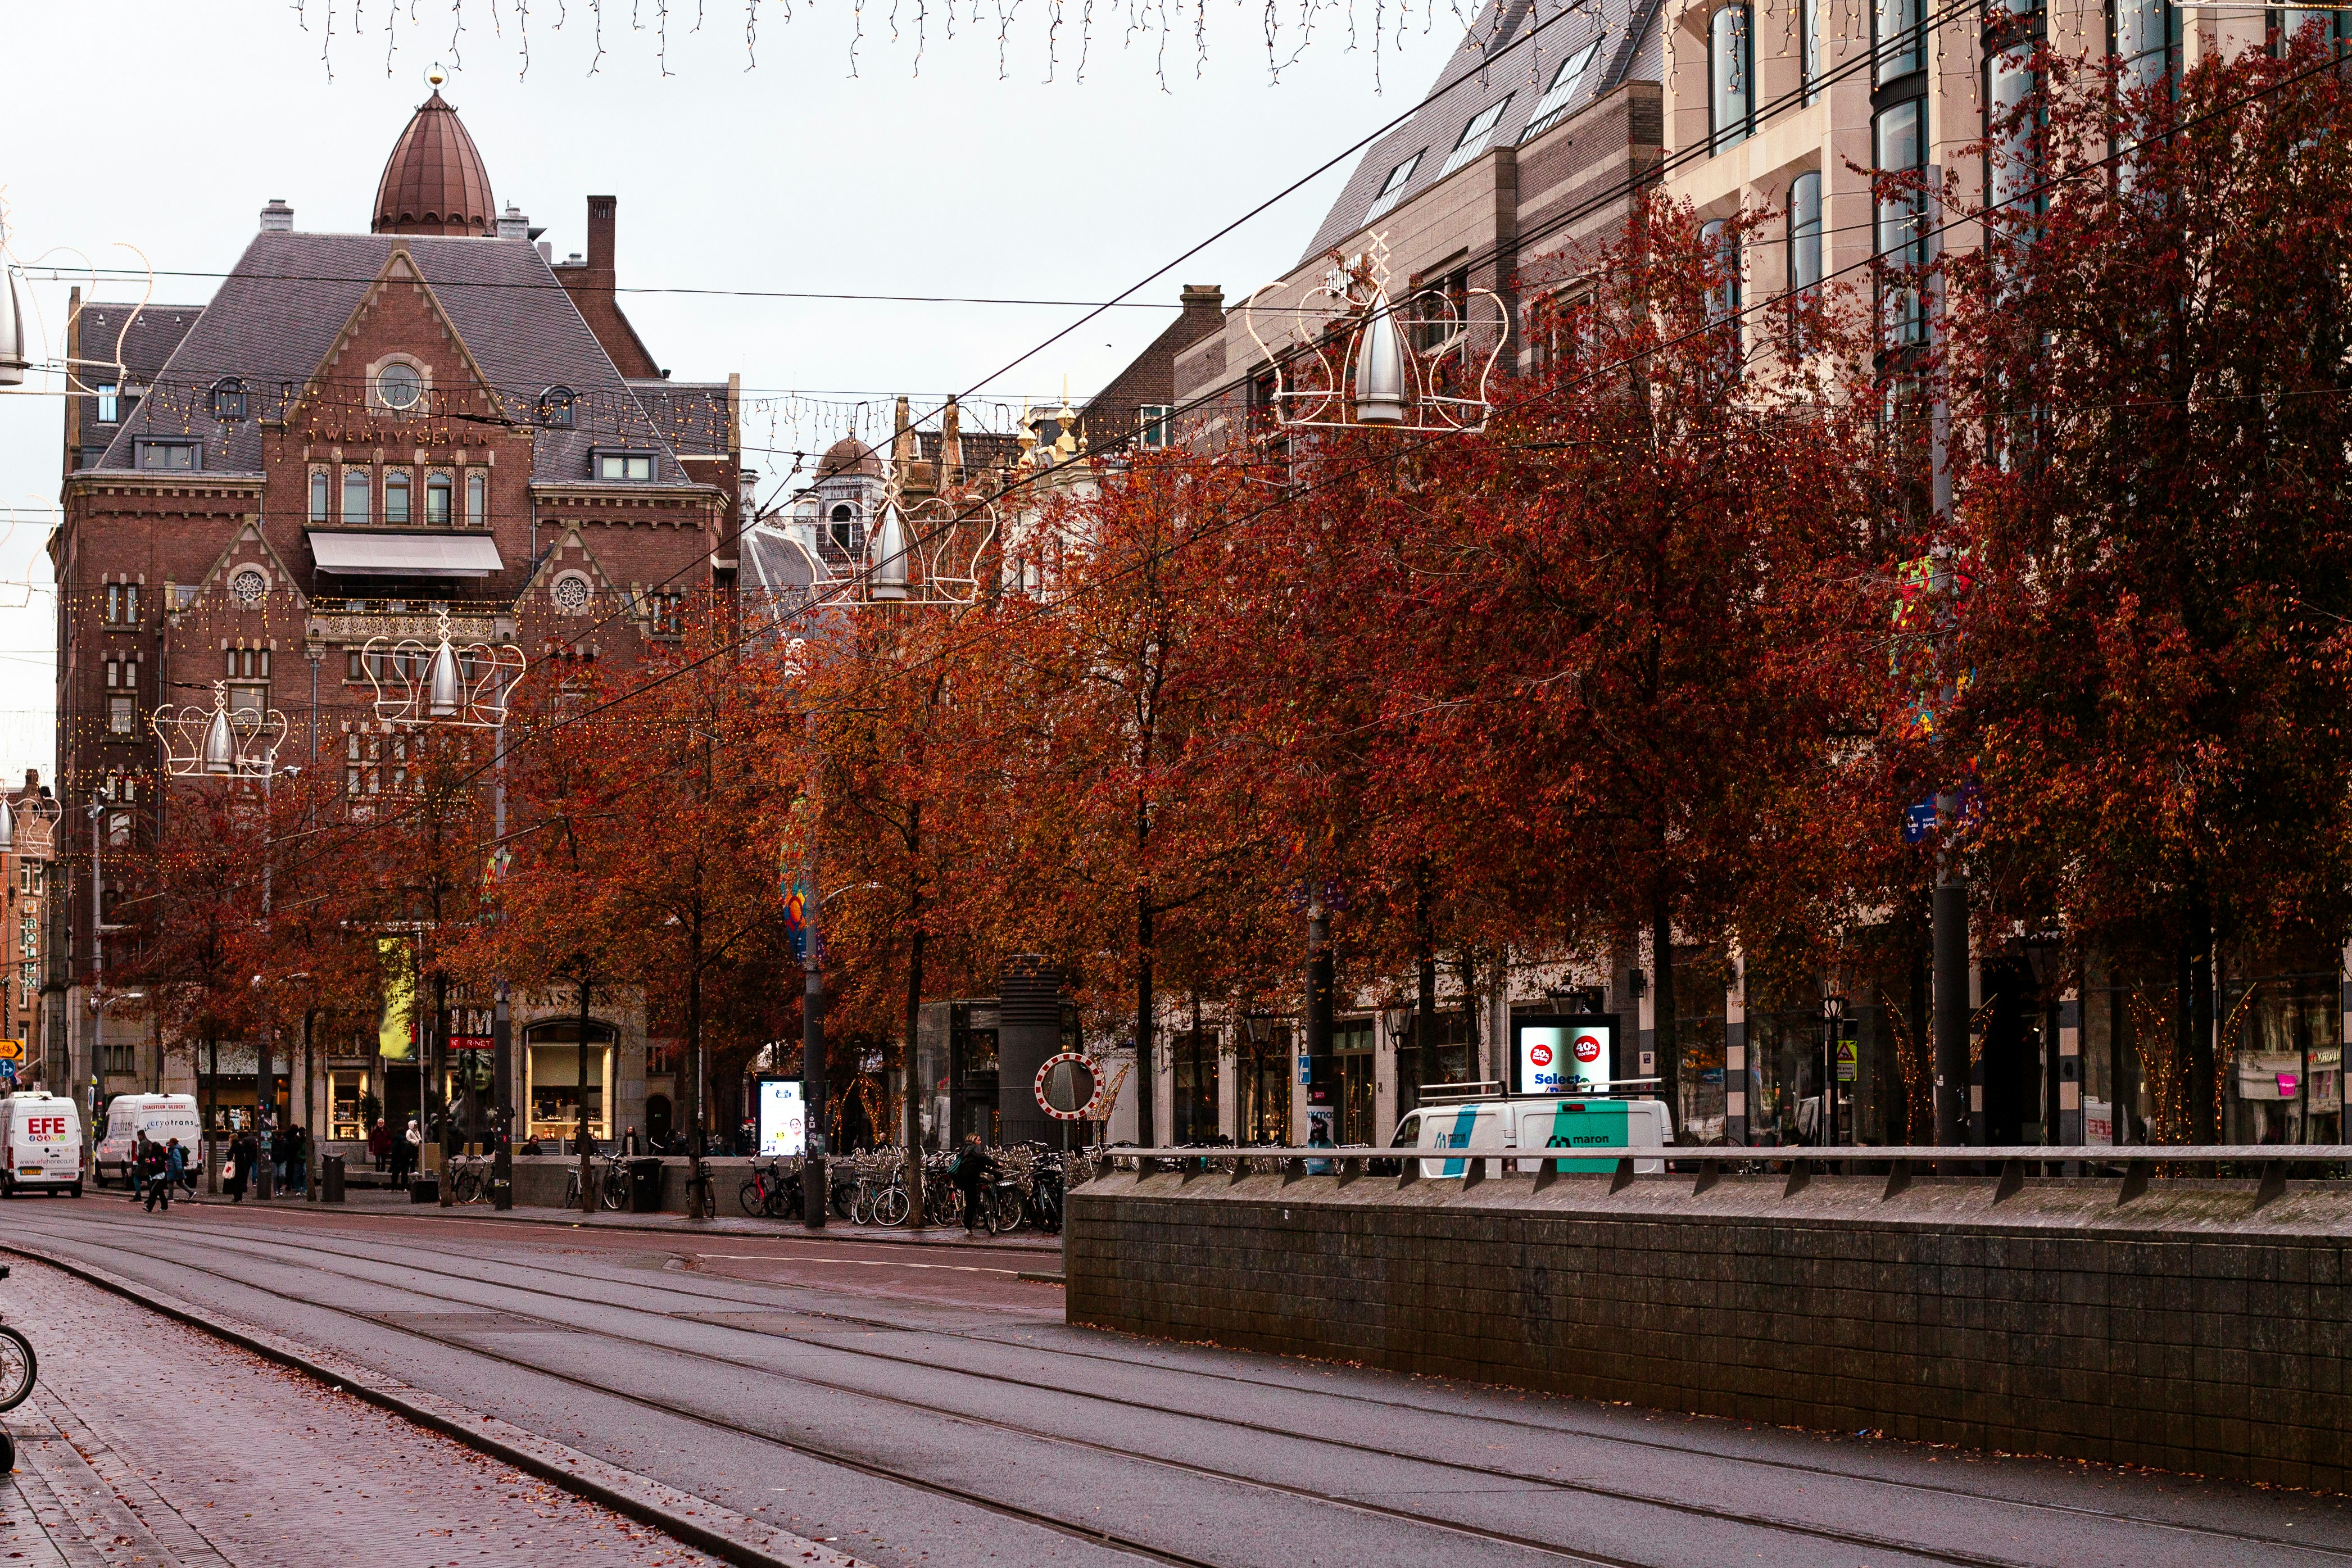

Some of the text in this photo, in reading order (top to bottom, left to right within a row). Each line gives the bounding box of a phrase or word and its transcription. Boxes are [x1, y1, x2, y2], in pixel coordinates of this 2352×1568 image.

[309, 429, 488, 444] TWENTY SEVEN
[26, 919, 35, 987] ROLEX
[1576, 1041, 1597, 1052] 40%
[1533, 1048, 1549, 1058] 20%
[1535, 1073, 1580, 1084] Select
[29, 1118, 65, 1134] EFE
[1573, 1135, 1609, 1144] maron
